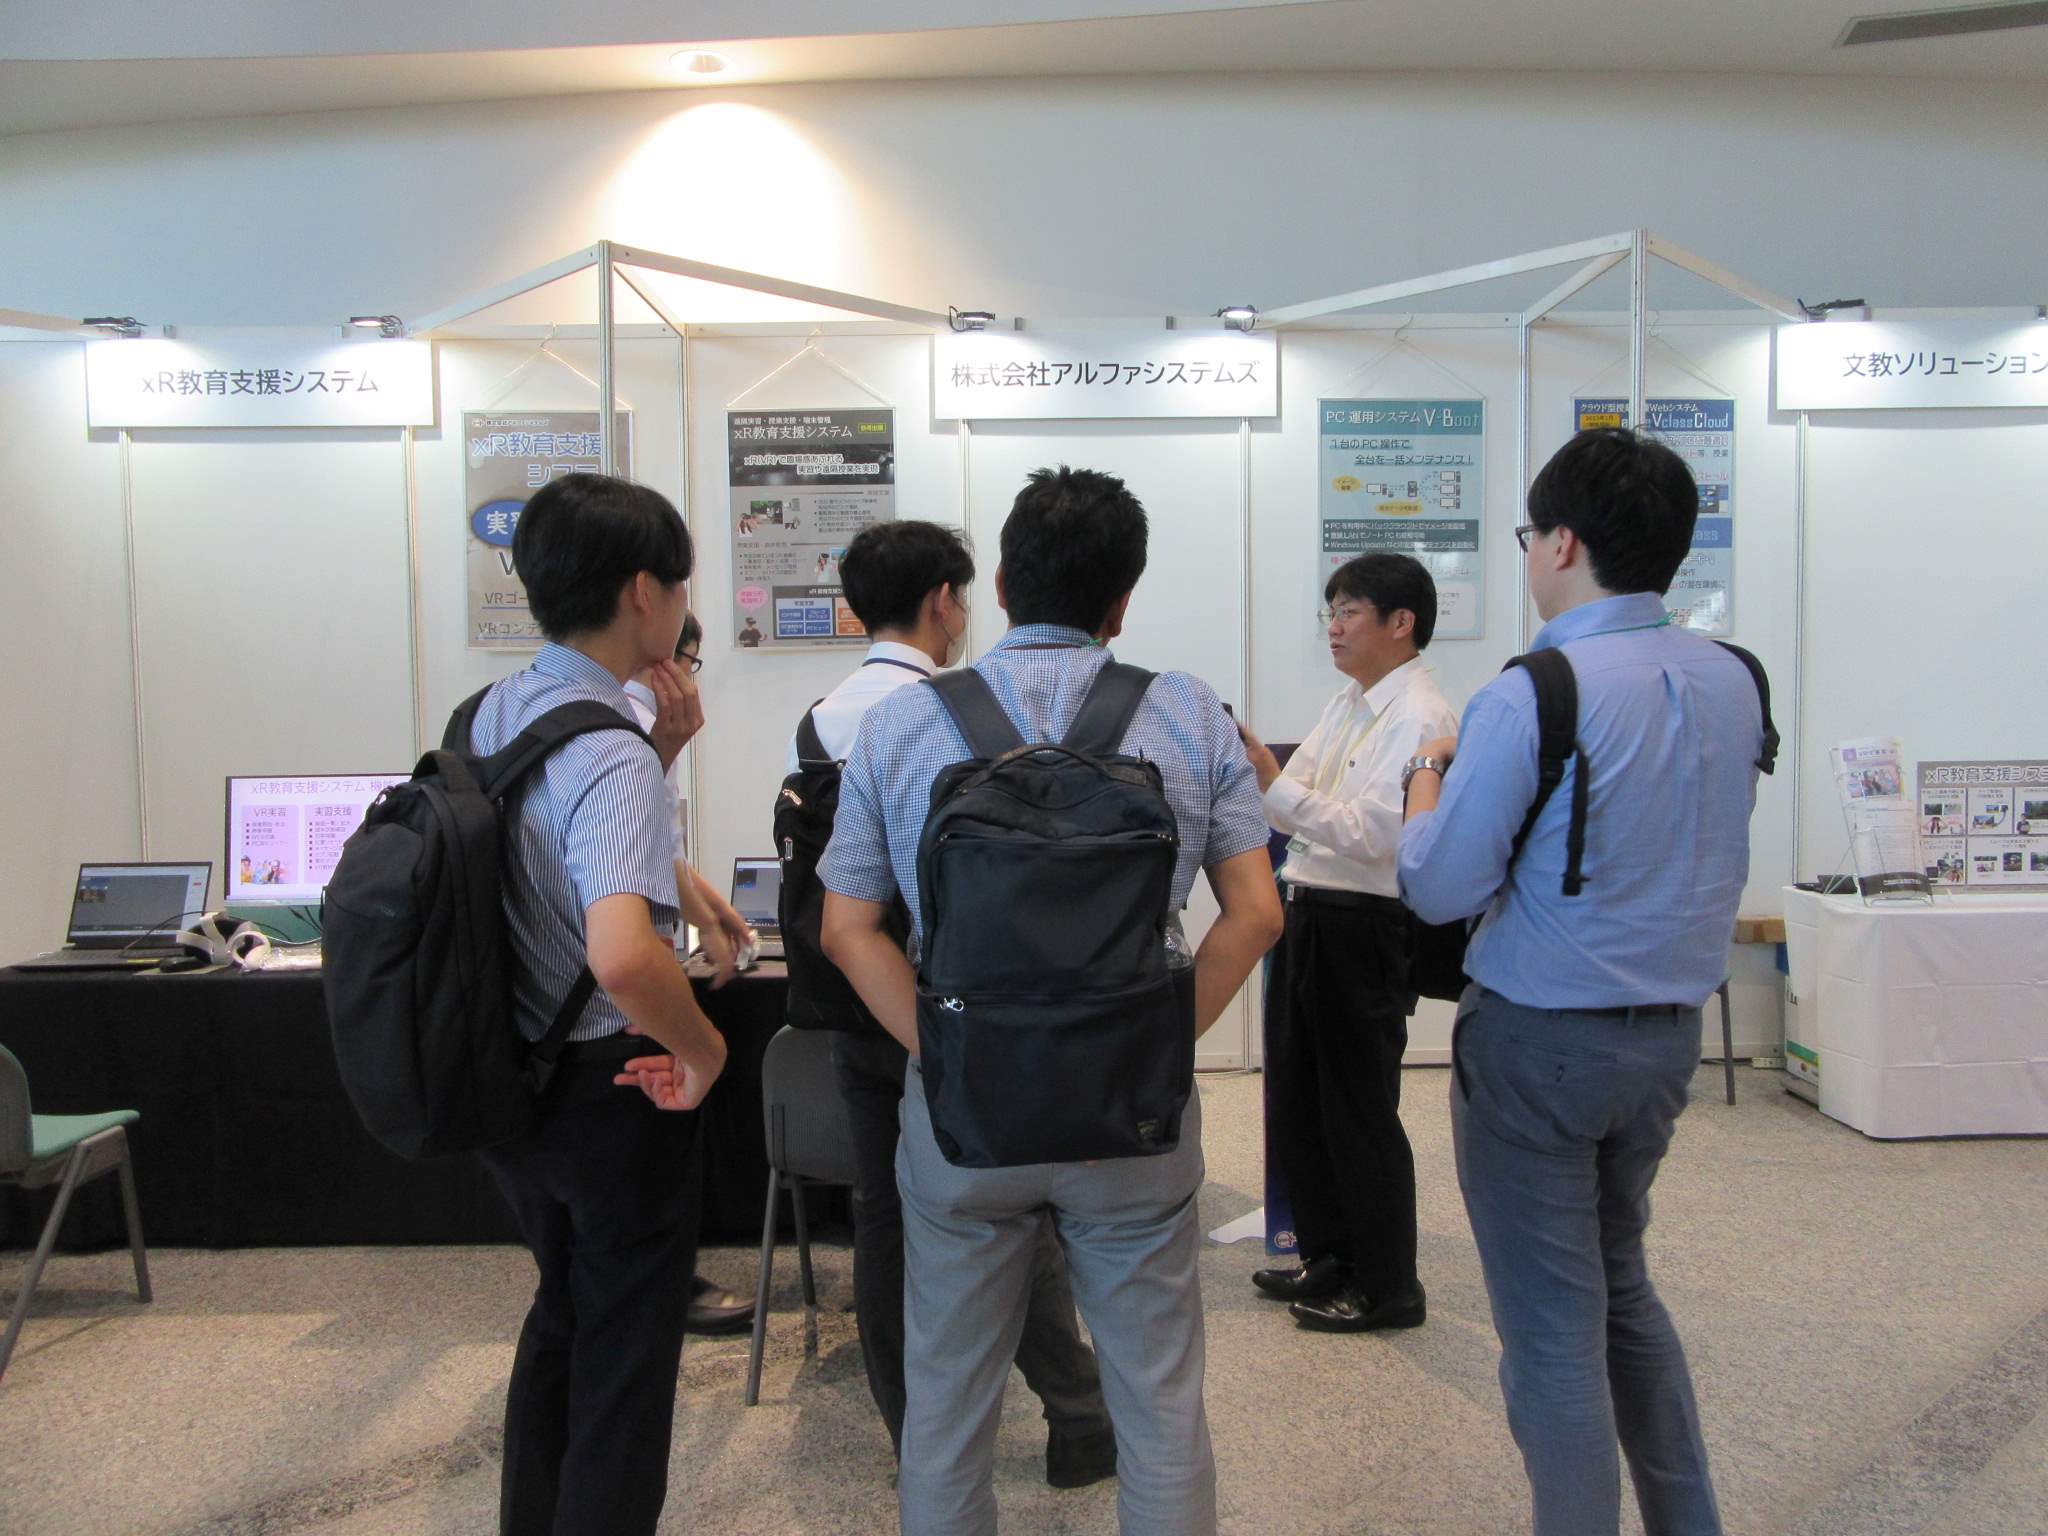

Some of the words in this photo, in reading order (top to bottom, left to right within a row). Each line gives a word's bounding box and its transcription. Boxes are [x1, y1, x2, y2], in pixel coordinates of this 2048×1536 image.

[141, 368, 380, 396] xR教育支援システム
[951, 360, 1262, 388] 株式会社アルファシステムズ
[1842, 351, 2048, 388] 文教ソリューション
[734, 425, 853, 440] xR教育支援システム
